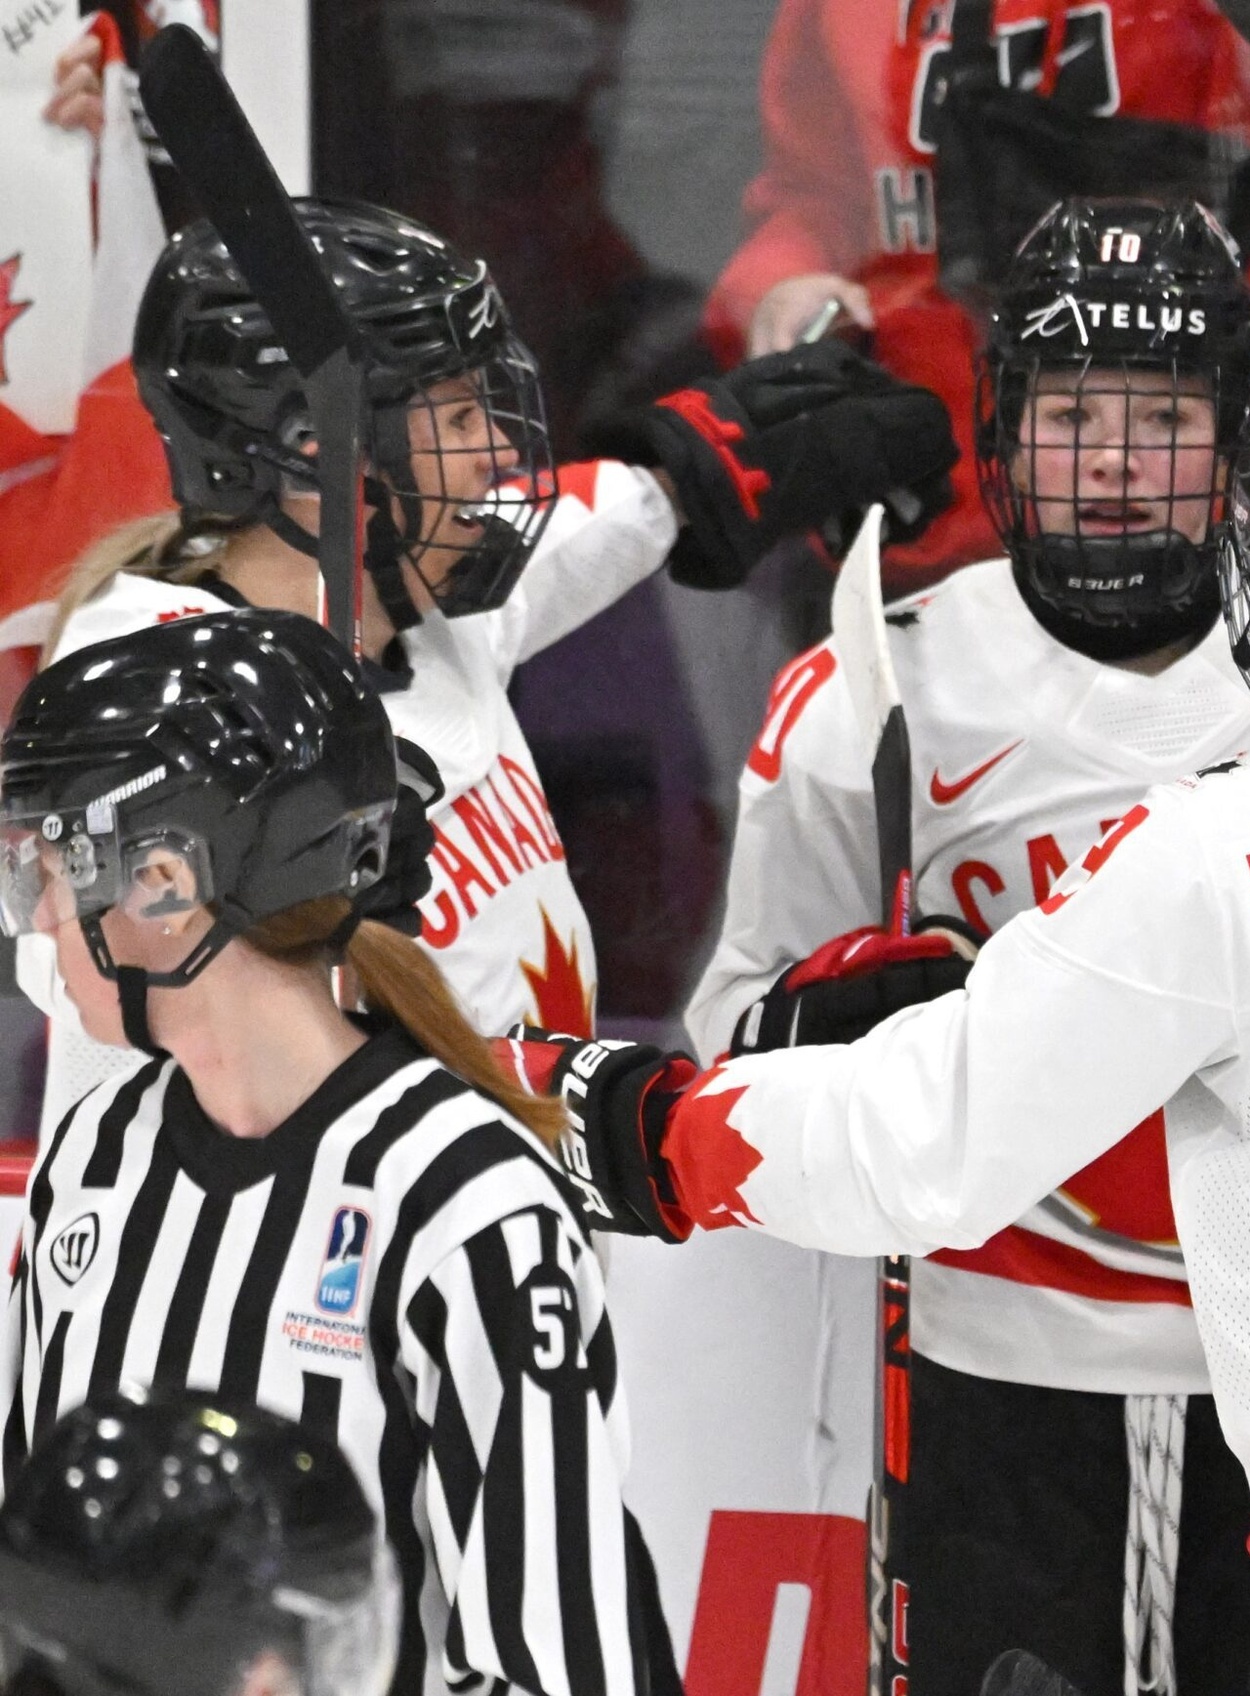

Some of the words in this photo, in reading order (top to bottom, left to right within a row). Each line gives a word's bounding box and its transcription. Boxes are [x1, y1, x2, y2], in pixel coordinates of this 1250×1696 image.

[1100, 231, 1141, 262] 10
[1086, 303, 1206, 336] TELUS
[419, 753, 566, 950] CANAD
[282, 1323, 307, 1340] ICE
[312, 1329, 365, 1349] HOCKE
[289, 1339, 363, 1361] FEDERATION
